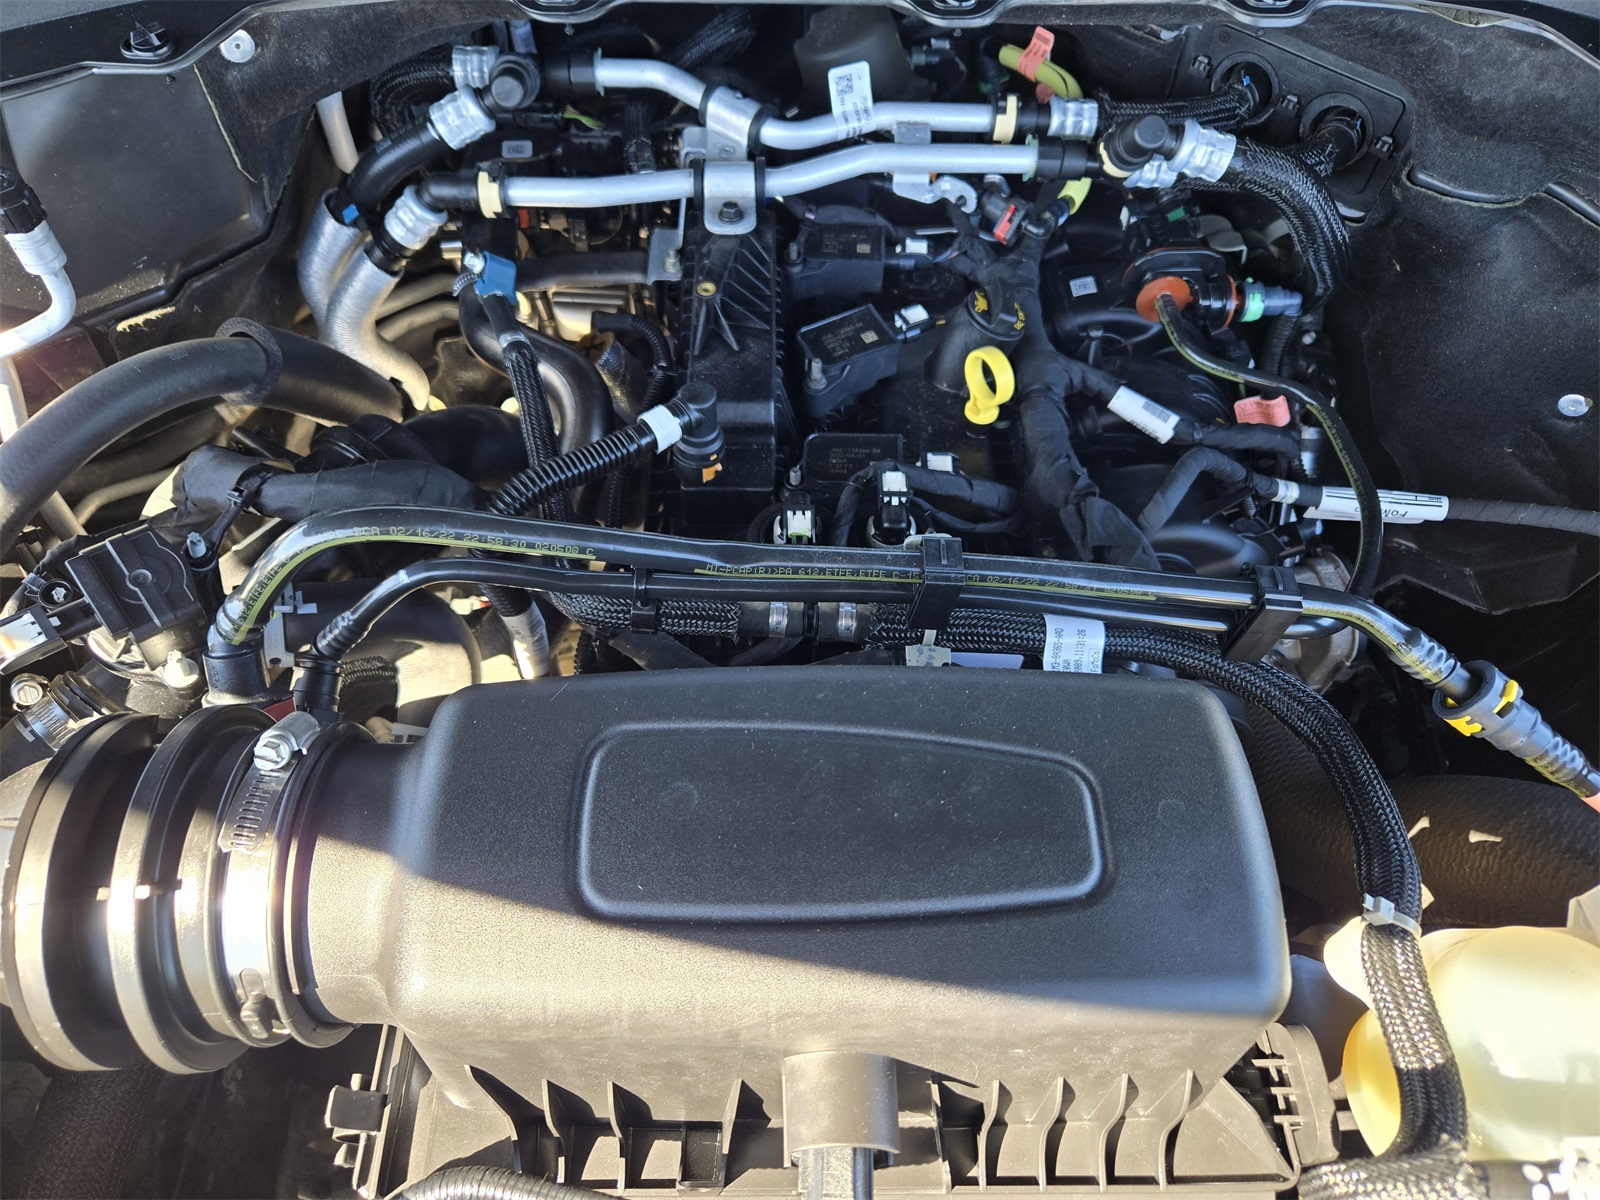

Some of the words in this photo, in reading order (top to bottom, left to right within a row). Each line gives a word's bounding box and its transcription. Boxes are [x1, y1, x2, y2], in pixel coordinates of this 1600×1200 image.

[389, 526, 456, 540] 02/16/22
[463, 533, 527, 549] 22:58:30
[535, 542, 579, 555] 020508
[586, 547, 594, 556] C
[986, 576, 1039, 586] 02/16/22
